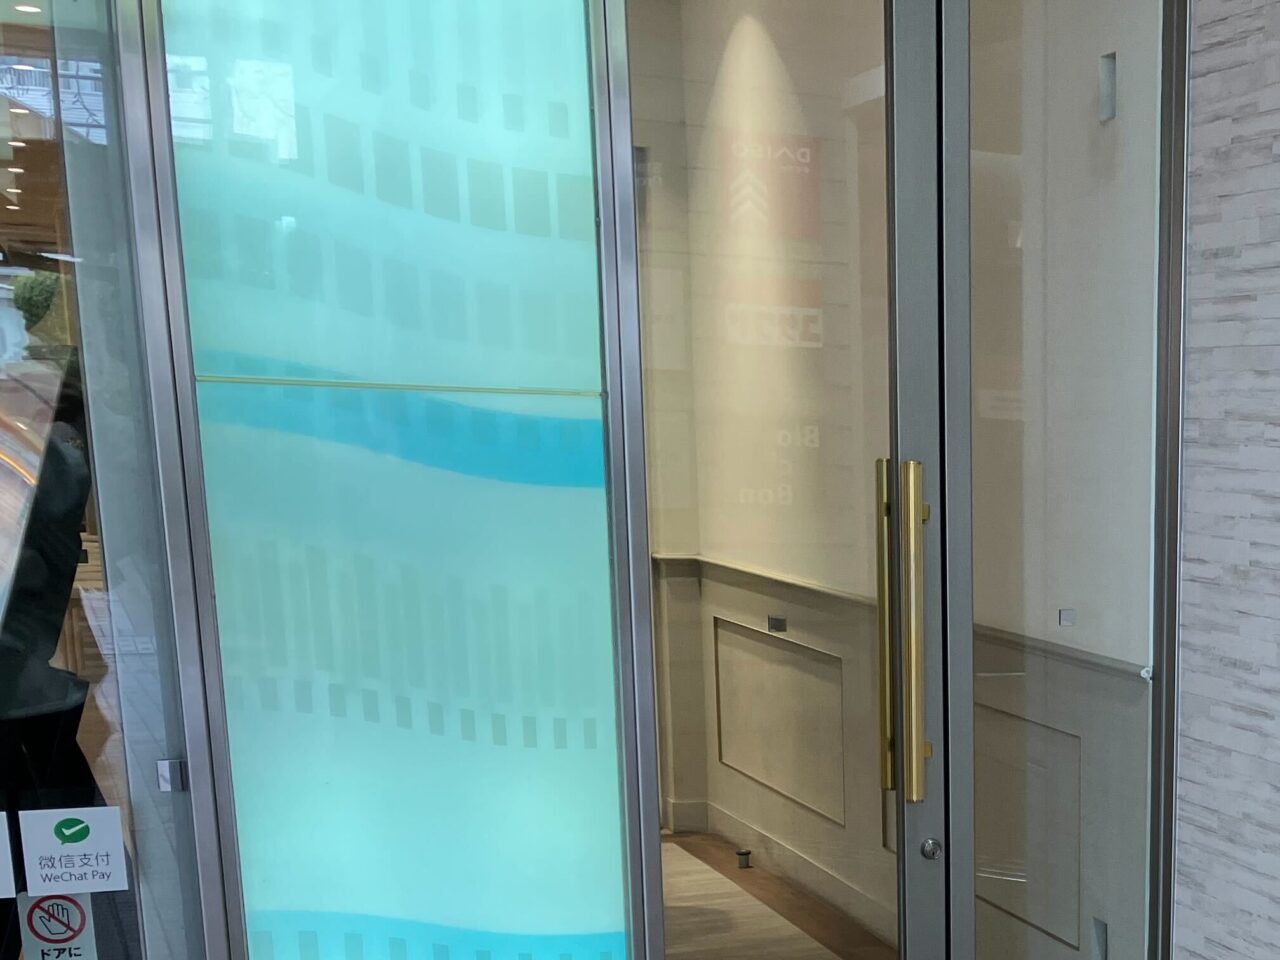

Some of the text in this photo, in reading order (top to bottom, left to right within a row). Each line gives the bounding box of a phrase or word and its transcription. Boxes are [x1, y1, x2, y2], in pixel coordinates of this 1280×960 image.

[38, 851, 111, 870] 微信支付
[40, 870, 112, 883] WeChat Pay
[40, 947, 82, 960] ドアに
